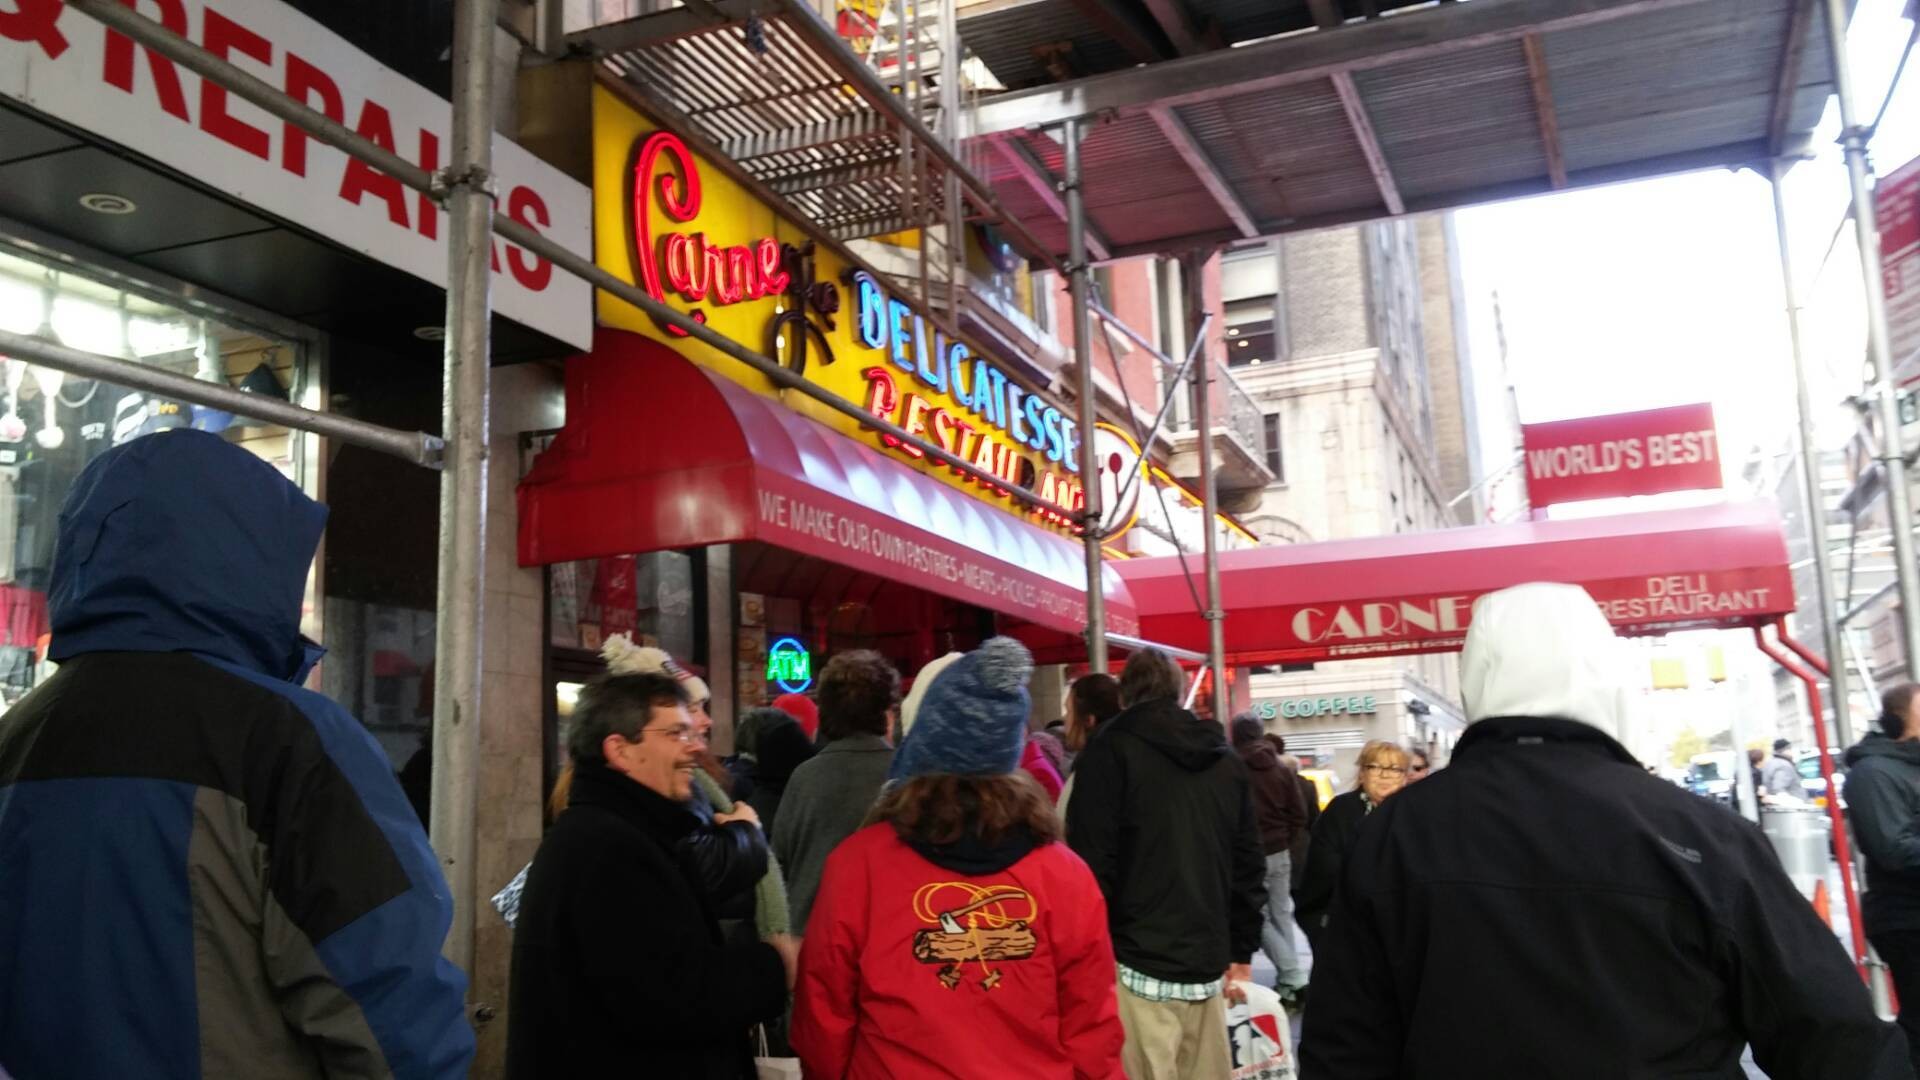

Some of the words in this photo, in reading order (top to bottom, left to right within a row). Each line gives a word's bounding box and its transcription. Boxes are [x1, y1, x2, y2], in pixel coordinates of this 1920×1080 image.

[103, 0, 552, 291] REPAIS
[854, 270, 1080, 473] DELICATESSE
[1528, 438, 1643, 479] WORLD'S
[1647, 429, 1714, 467] BEST
[758, 489, 787, 527] WE
[790, 500, 836, 542] MAKE
[838, 518, 870, 553] OUR
[872, 529, 907, 565] OWN
[907, 542, 958, 582] PASTRIES
[1598, 588, 1769, 619] RESTAURANT
[1647, 574, 1709, 597] DELI
[1292, 596, 1475, 643] CARNE
[767, 650, 811, 681] ATM
[1281, 696, 1377, 718] COFFEE
